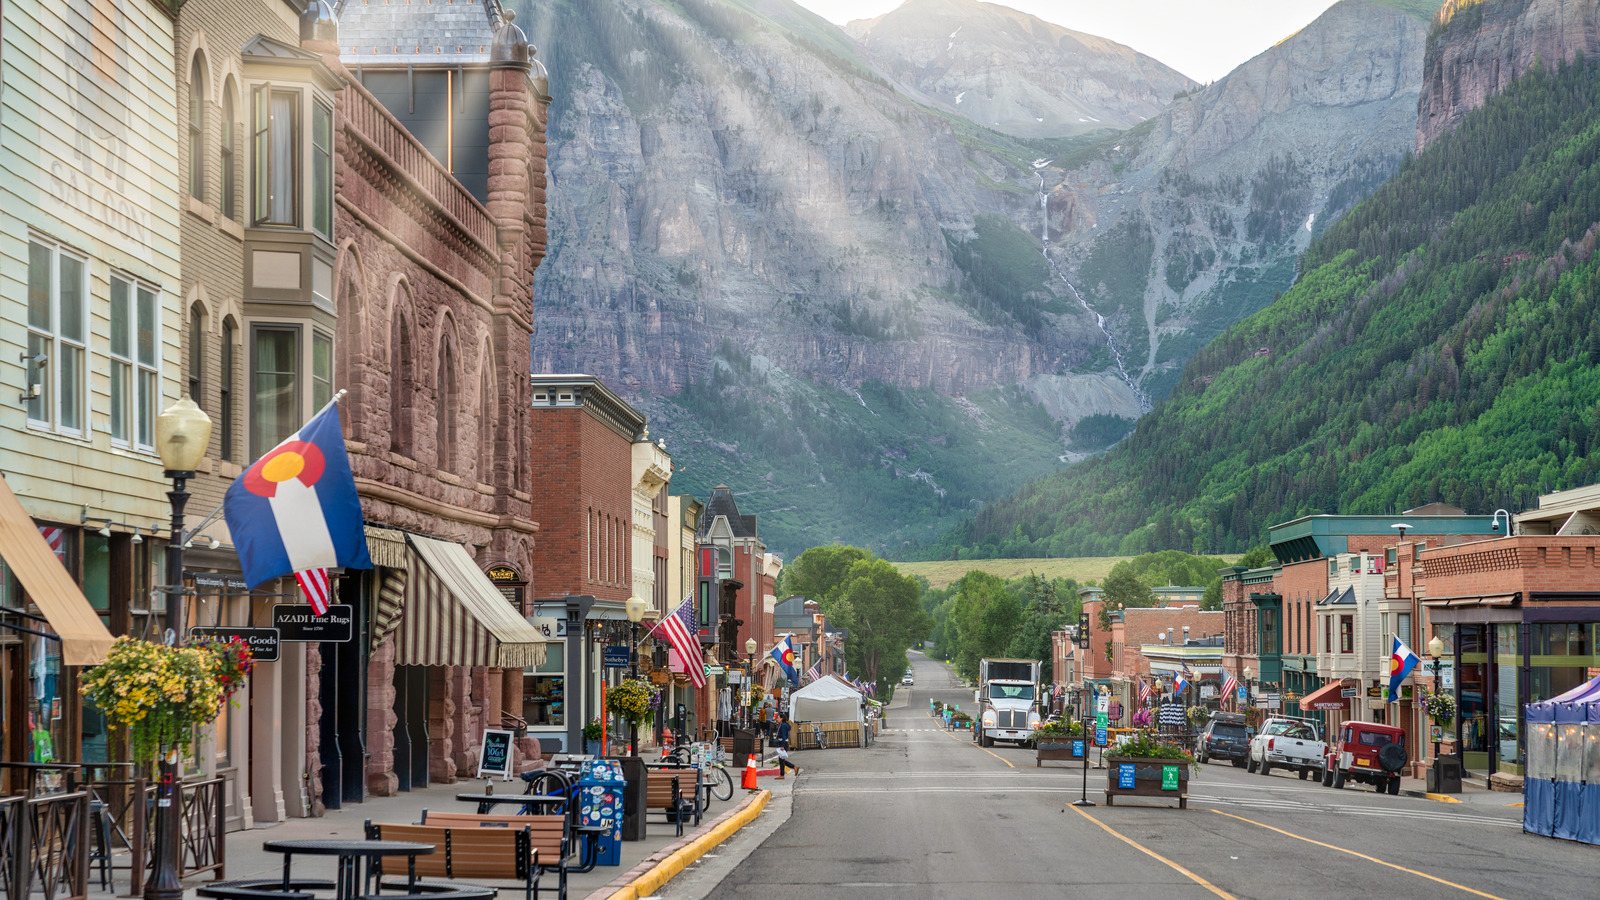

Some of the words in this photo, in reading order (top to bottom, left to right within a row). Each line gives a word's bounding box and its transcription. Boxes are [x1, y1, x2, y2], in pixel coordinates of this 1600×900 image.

[50, 160, 146, 246] SALOON
[277, 615, 309, 623] AZADI
[311, 615, 329, 623] Fine
[330, 615, 350, 625] Rugs
[249, 635, 277, 645] Goods
